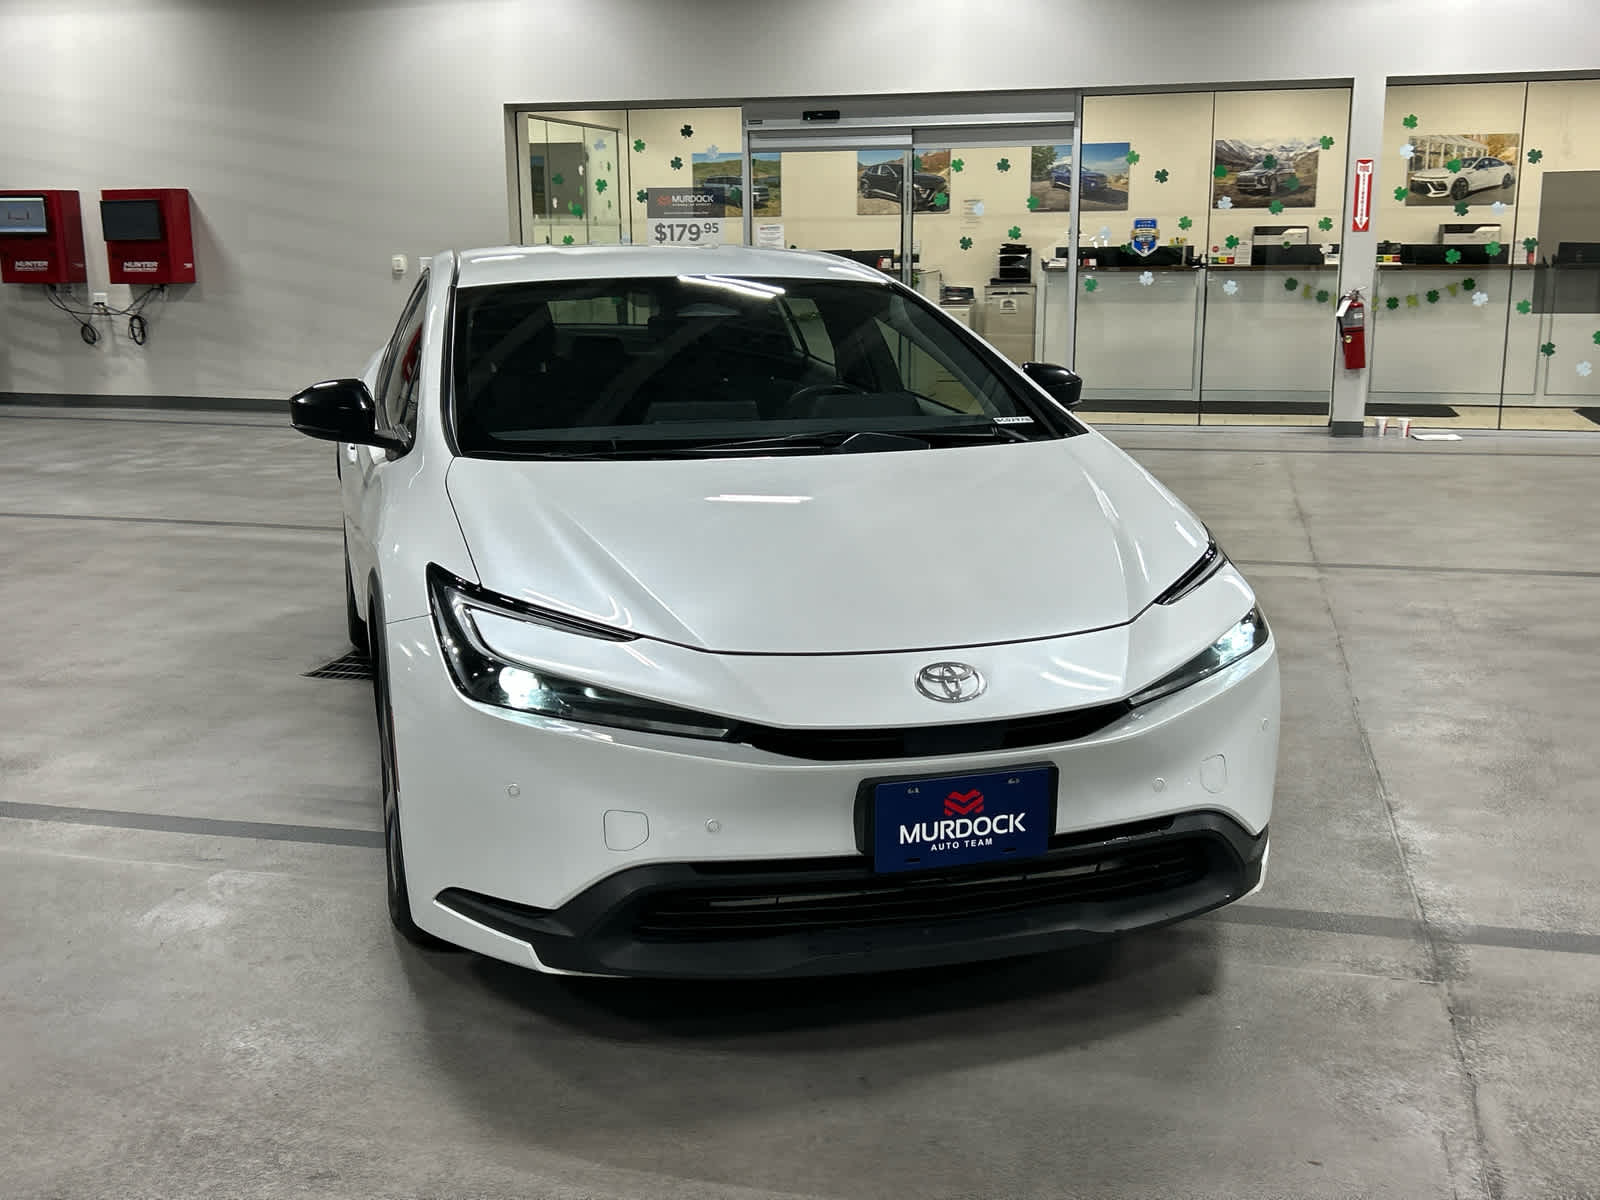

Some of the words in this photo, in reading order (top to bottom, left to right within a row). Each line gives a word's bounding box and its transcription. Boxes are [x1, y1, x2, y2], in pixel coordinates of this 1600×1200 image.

[671, 194, 714, 203] MURDOCK
[899, 812, 1026, 845] MURDOCK
[930, 840, 960, 852] AUTO
[964, 837, 993, 849] TEAM
